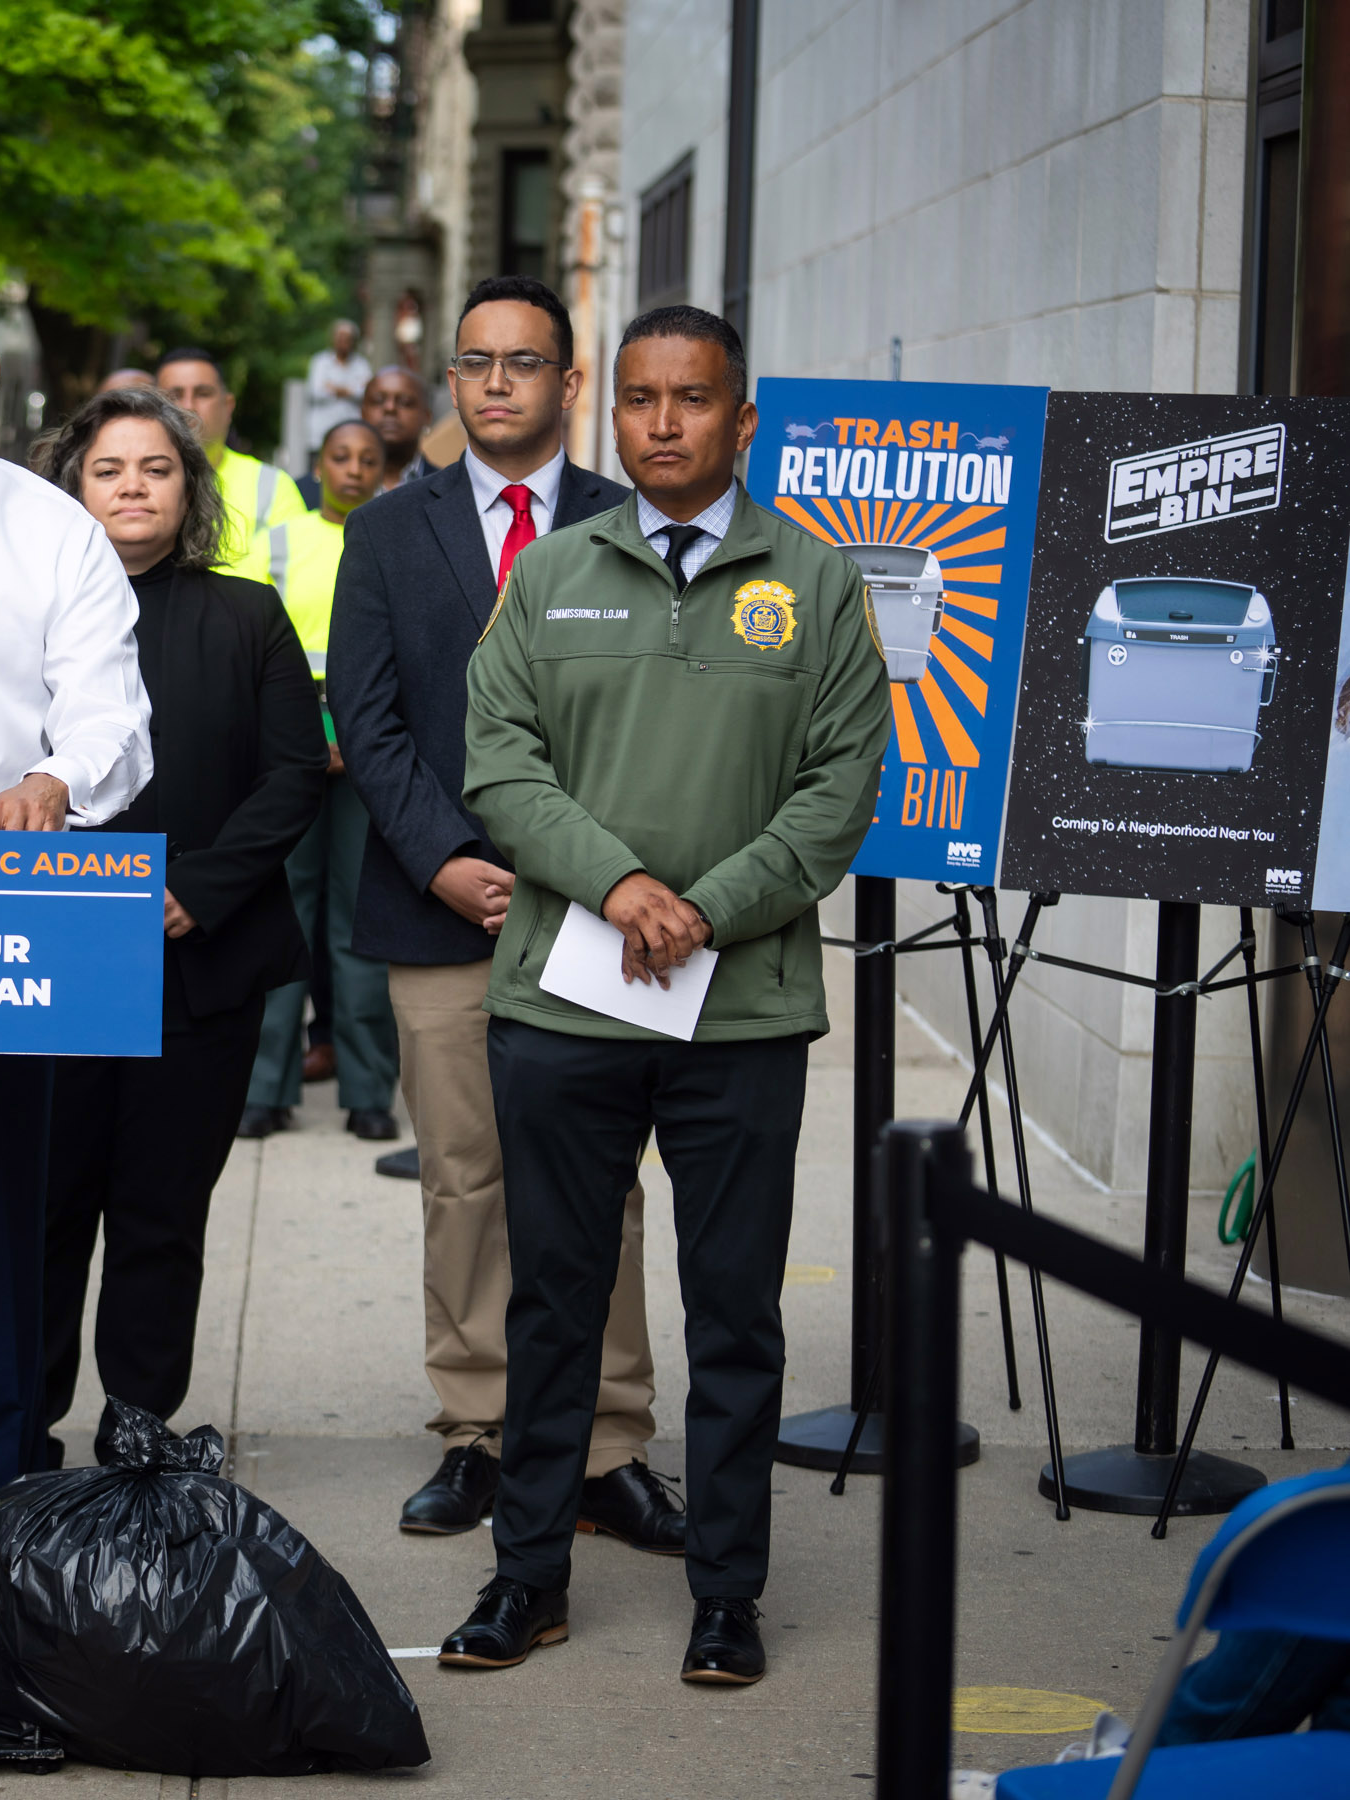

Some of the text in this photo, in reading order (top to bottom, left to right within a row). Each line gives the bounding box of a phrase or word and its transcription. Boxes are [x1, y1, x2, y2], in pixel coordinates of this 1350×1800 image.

[833, 417, 959, 450] TRASH
[1179, 445, 1210, 460] THE
[777, 445, 1014, 505] REVOLUTION
[1113, 441, 1279, 508] EMPIRE
[1158, 483, 1233, 528] BIN
[546, 608, 629, 620] COMMISSIONER LOJAN
[901, 766, 968, 830] BIN
[1052, 816, 1275, 842] Coming To A Neighborhood Near You
[948, 841, 982, 858] NYC
[32, 852, 152, 878] ADAMS
[1266, 868, 1302, 885] NYC
